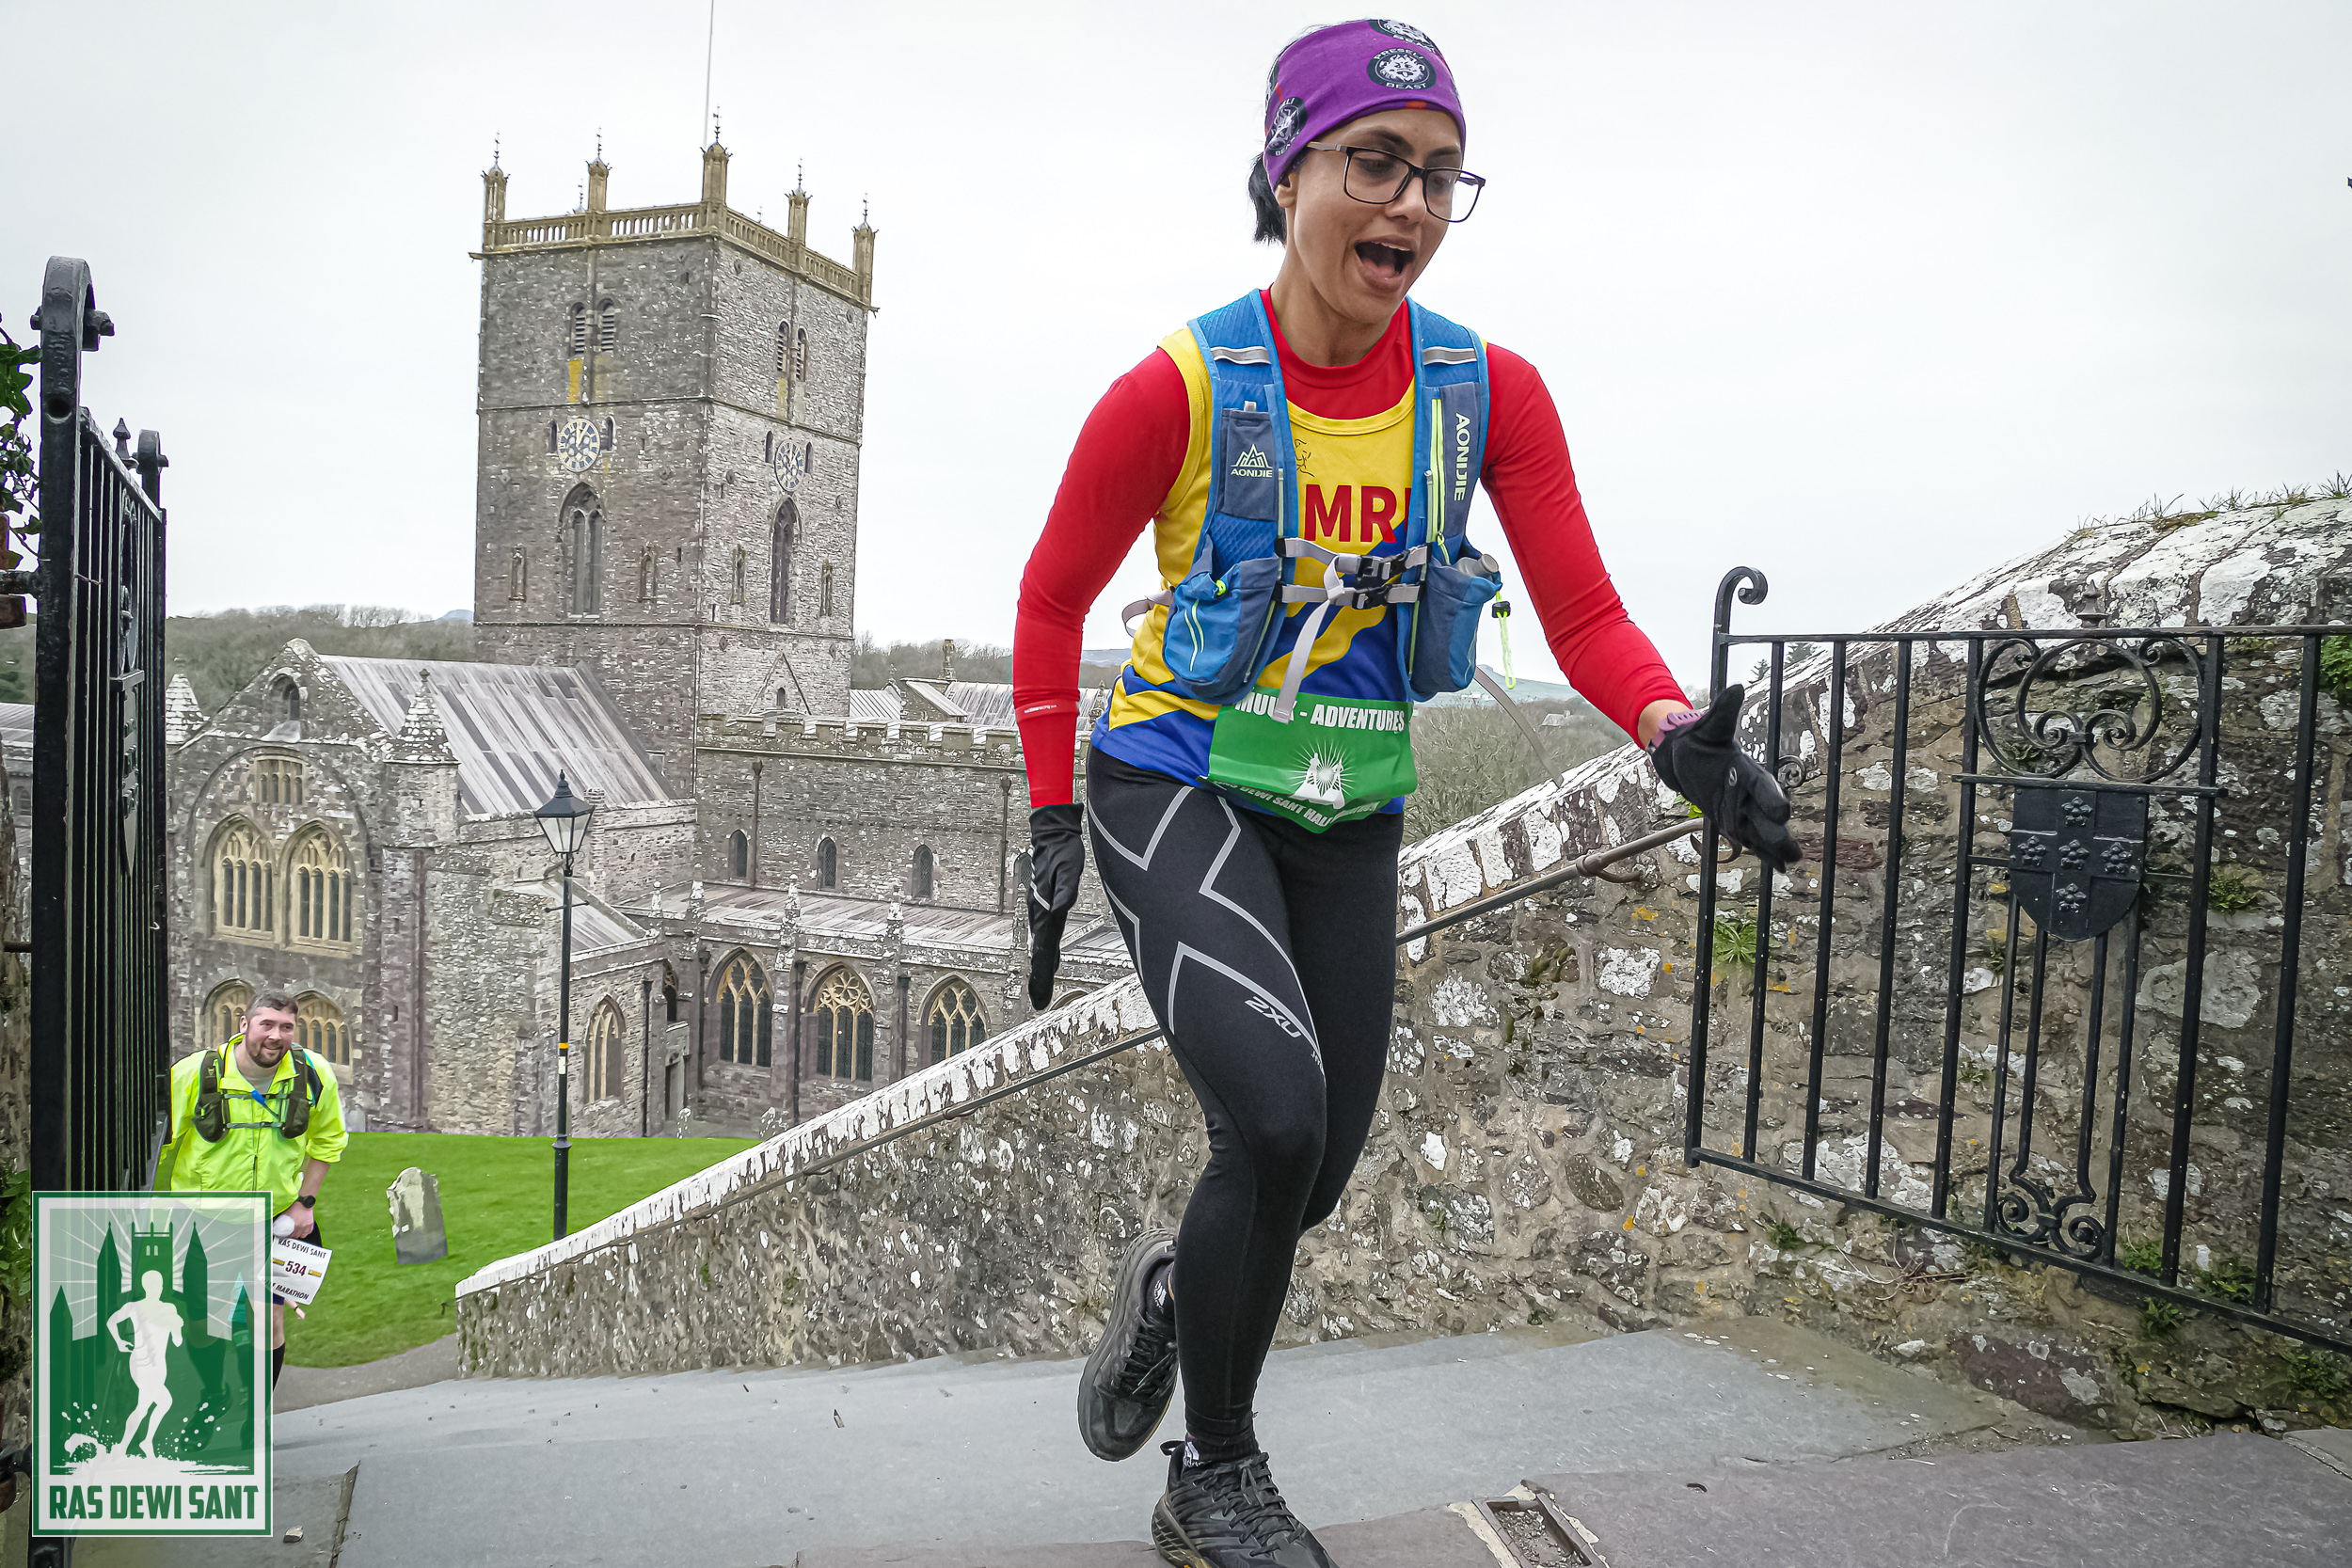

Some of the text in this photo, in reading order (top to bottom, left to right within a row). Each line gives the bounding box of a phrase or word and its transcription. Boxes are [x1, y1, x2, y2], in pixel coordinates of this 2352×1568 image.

[1386, 82, 1427, 90] BEAST
[1454, 412, 1470, 501] AONIJIE
[1231, 467, 1273, 479] AONIJIE
[1304, 483, 1411, 544] MR
[1310, 704, 1406, 732] ADVENTURES
[1272, 797, 1307, 815] SANT
[1244, 996, 1302, 1037] 2XU
[278, 1238, 326, 1259] RAS DEWI SANT
[285, 1260, 308, 1276] 534
[276, 1284, 310, 1300] MARATHON
